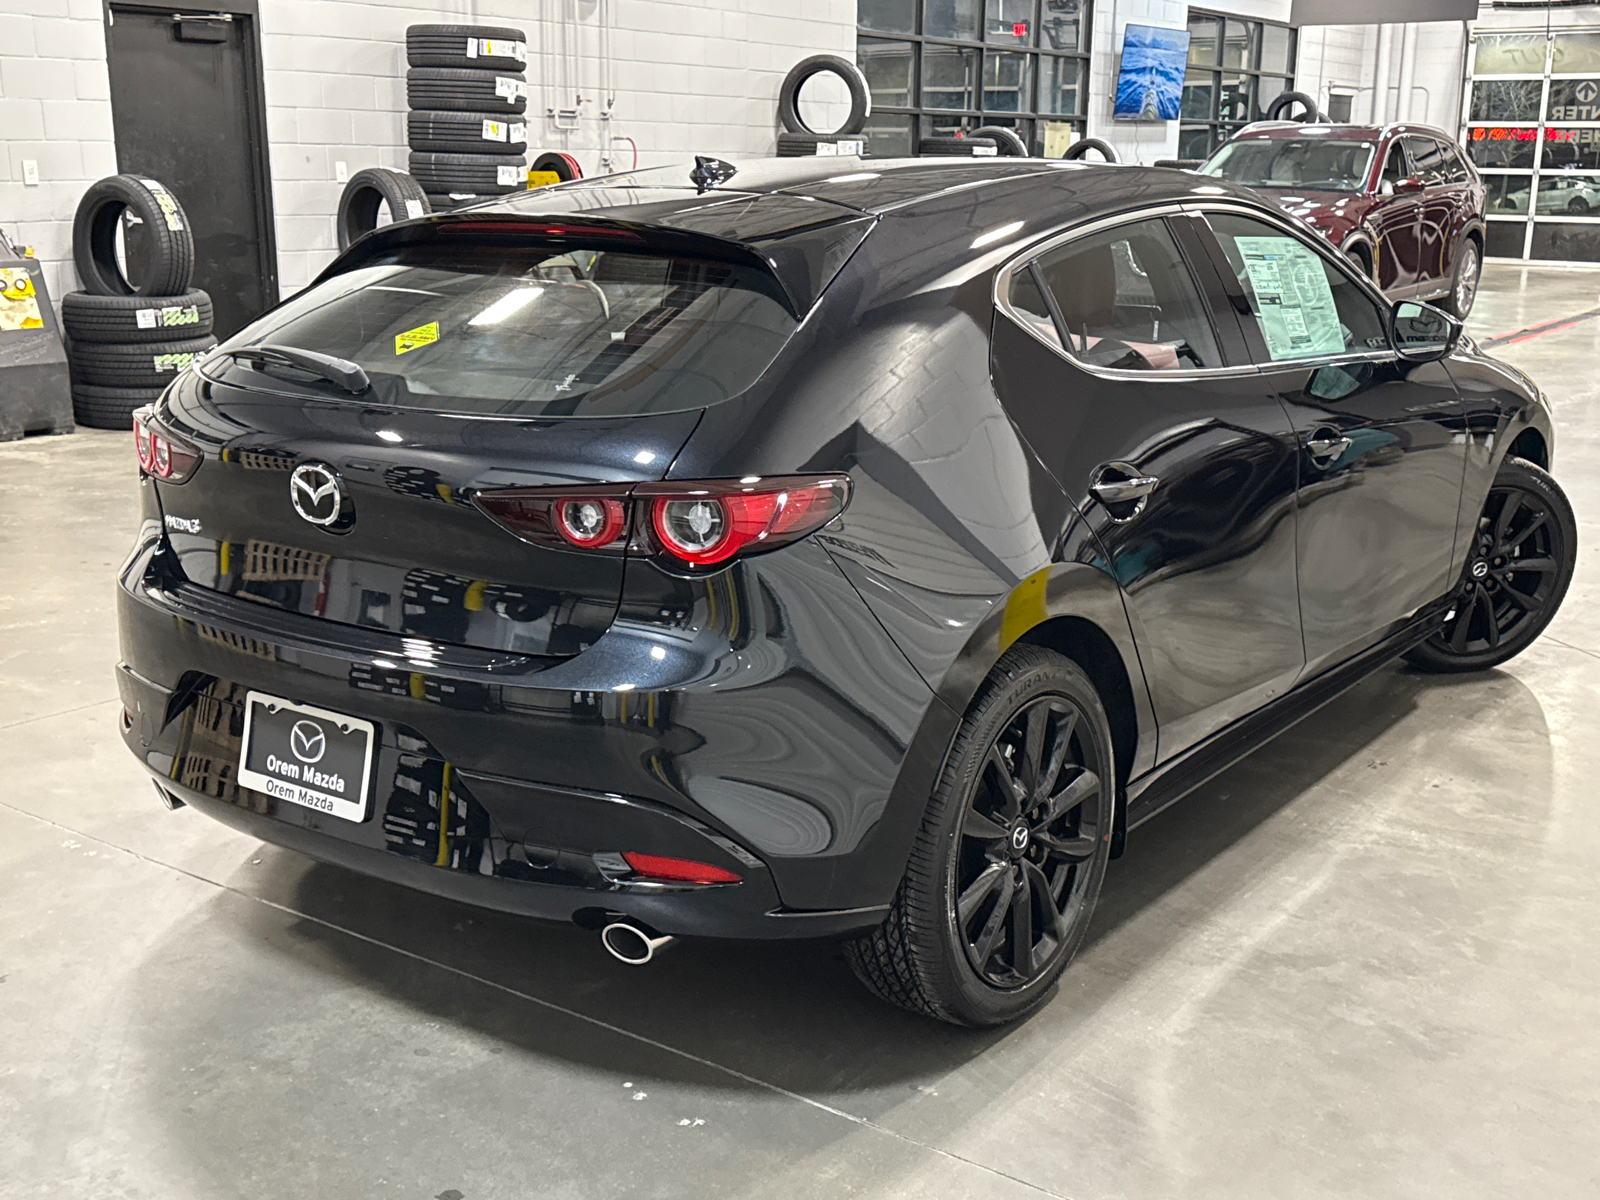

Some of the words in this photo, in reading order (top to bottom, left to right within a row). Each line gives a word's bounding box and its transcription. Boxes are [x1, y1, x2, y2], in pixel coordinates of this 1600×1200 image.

[1007, 670, 1062, 705] TURANZ
[266, 754, 300, 779] Orem
[302, 765, 345, 793] Mazda
[266, 779, 295, 799] Orem
[297, 788, 334, 812] Mazda
